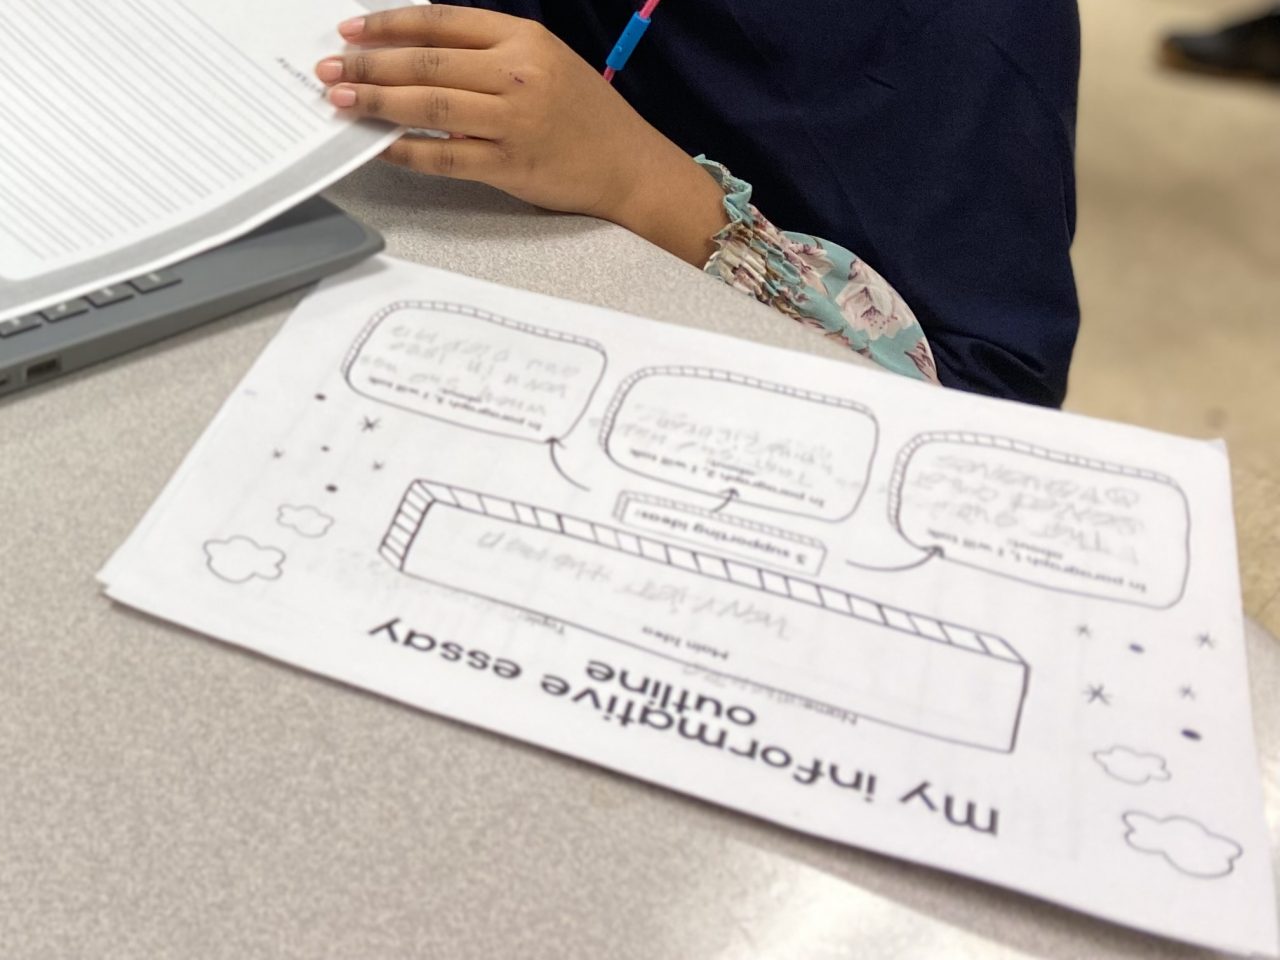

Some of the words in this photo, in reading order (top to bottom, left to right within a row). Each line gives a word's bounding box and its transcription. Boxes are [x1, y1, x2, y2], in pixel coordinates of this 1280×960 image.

[634, 509, 689, 534] ideas:
[692, 522, 791, 558] supporting
[367, 617, 523, 682] essay
[641, 626, 682, 647] Idea
[685, 640, 730, 660] Main
[584, 659, 758, 727] outline
[539, 674, 878, 803] informative
[898, 781, 1000, 837] my
